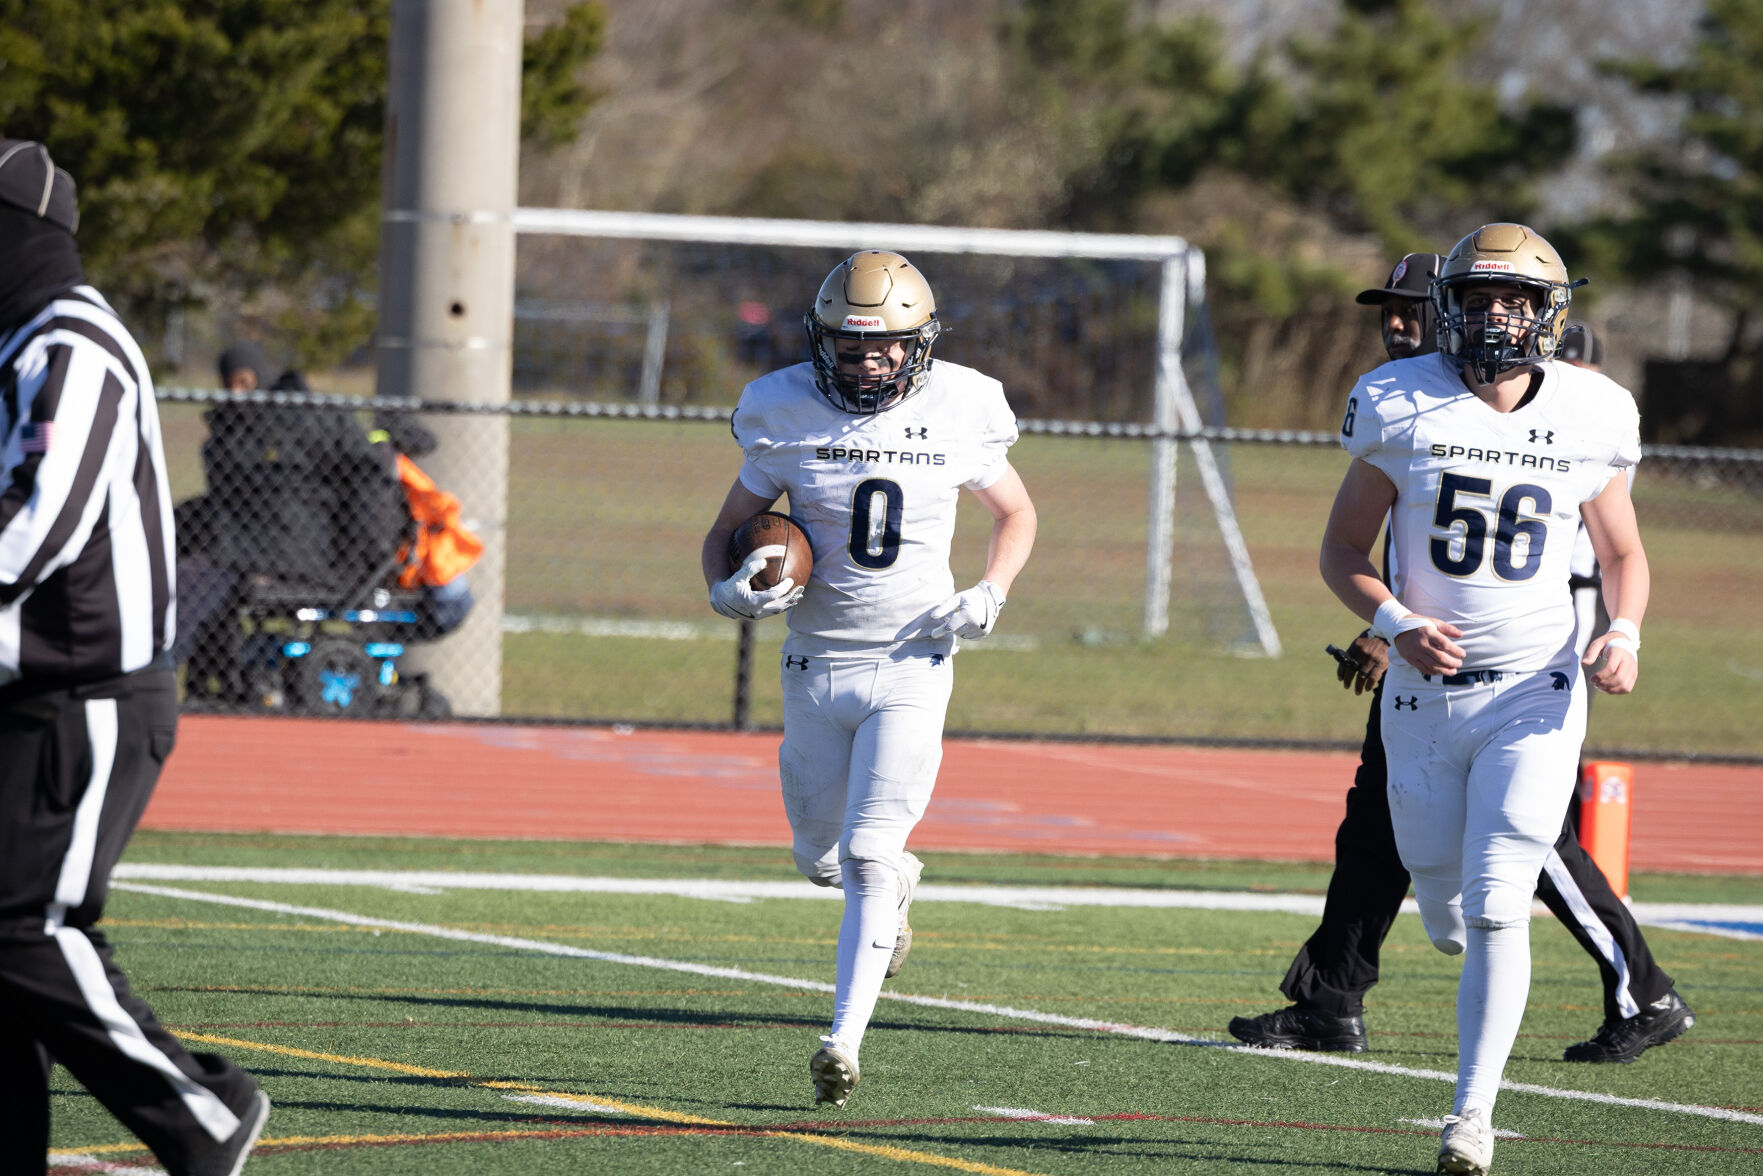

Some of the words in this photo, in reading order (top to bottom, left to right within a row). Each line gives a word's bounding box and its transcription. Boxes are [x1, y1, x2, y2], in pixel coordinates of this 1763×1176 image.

[1474, 263, 1510, 271] Riddell
[847, 318, 880, 327] Riddell
[816, 447, 946, 466] SPARTANS
[1431, 443, 1571, 473] SPARTANS
[848, 477, 904, 571] 0
[1429, 470, 1553, 583] 56
